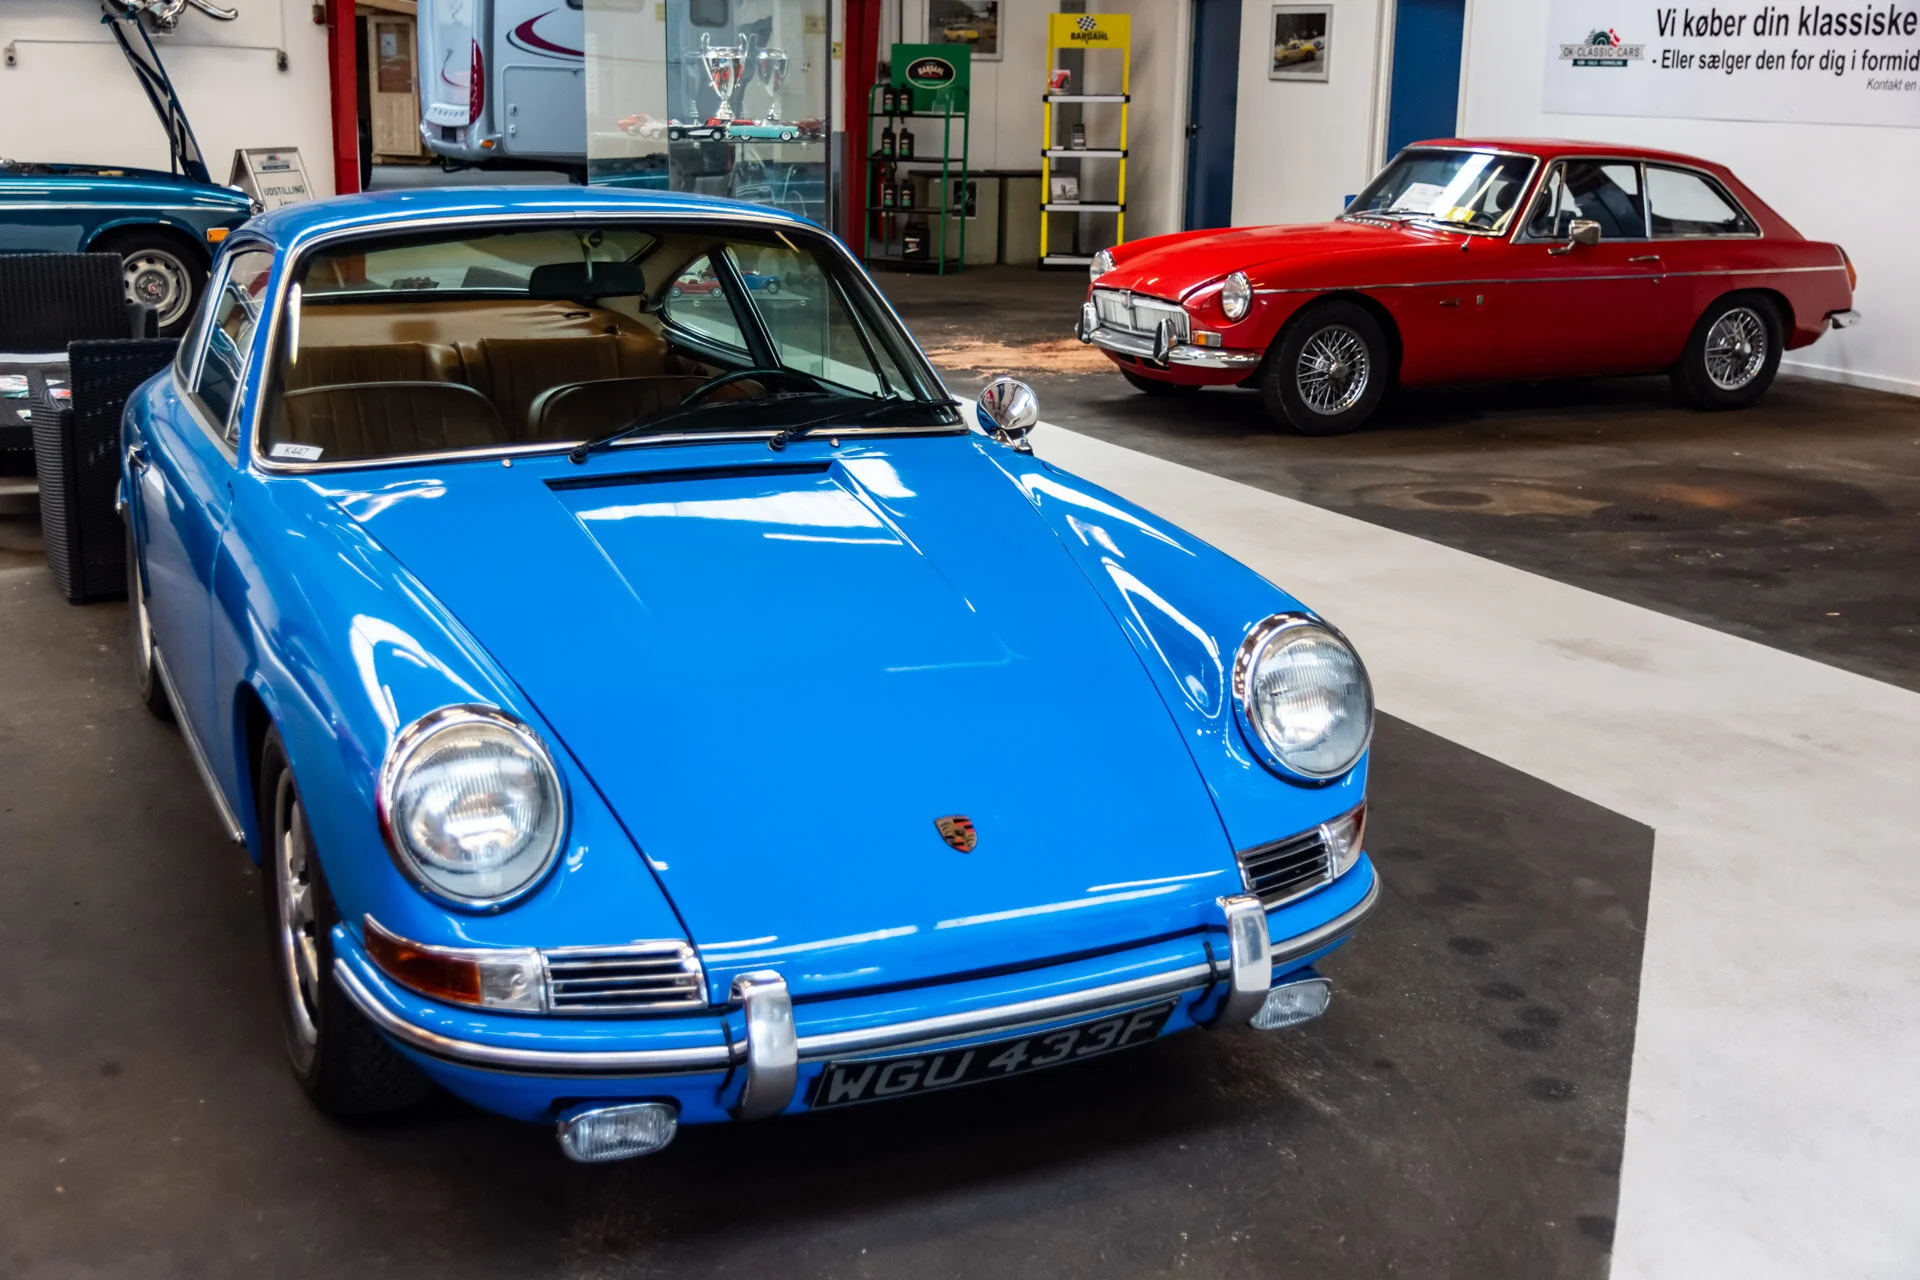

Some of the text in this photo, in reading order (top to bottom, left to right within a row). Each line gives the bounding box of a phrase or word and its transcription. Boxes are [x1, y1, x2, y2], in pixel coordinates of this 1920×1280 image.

[1657, 4, 1918, 37] Vi køber din klassiske
[1070, 32, 1109, 44] BARDAHL
[1661, 49, 1695, 69] Eller
[1698, 49, 1751, 75] sælger
[1755, 49, 1785, 70] den
[1791, 49, 1815, 70] for
[1819, 49, 1846, 76] dig
[1851, 49, 1857, 70] i
[1866, 78, 1917, 91] Kontakt en
[828, 1006, 1170, 1103] WGU 433F
